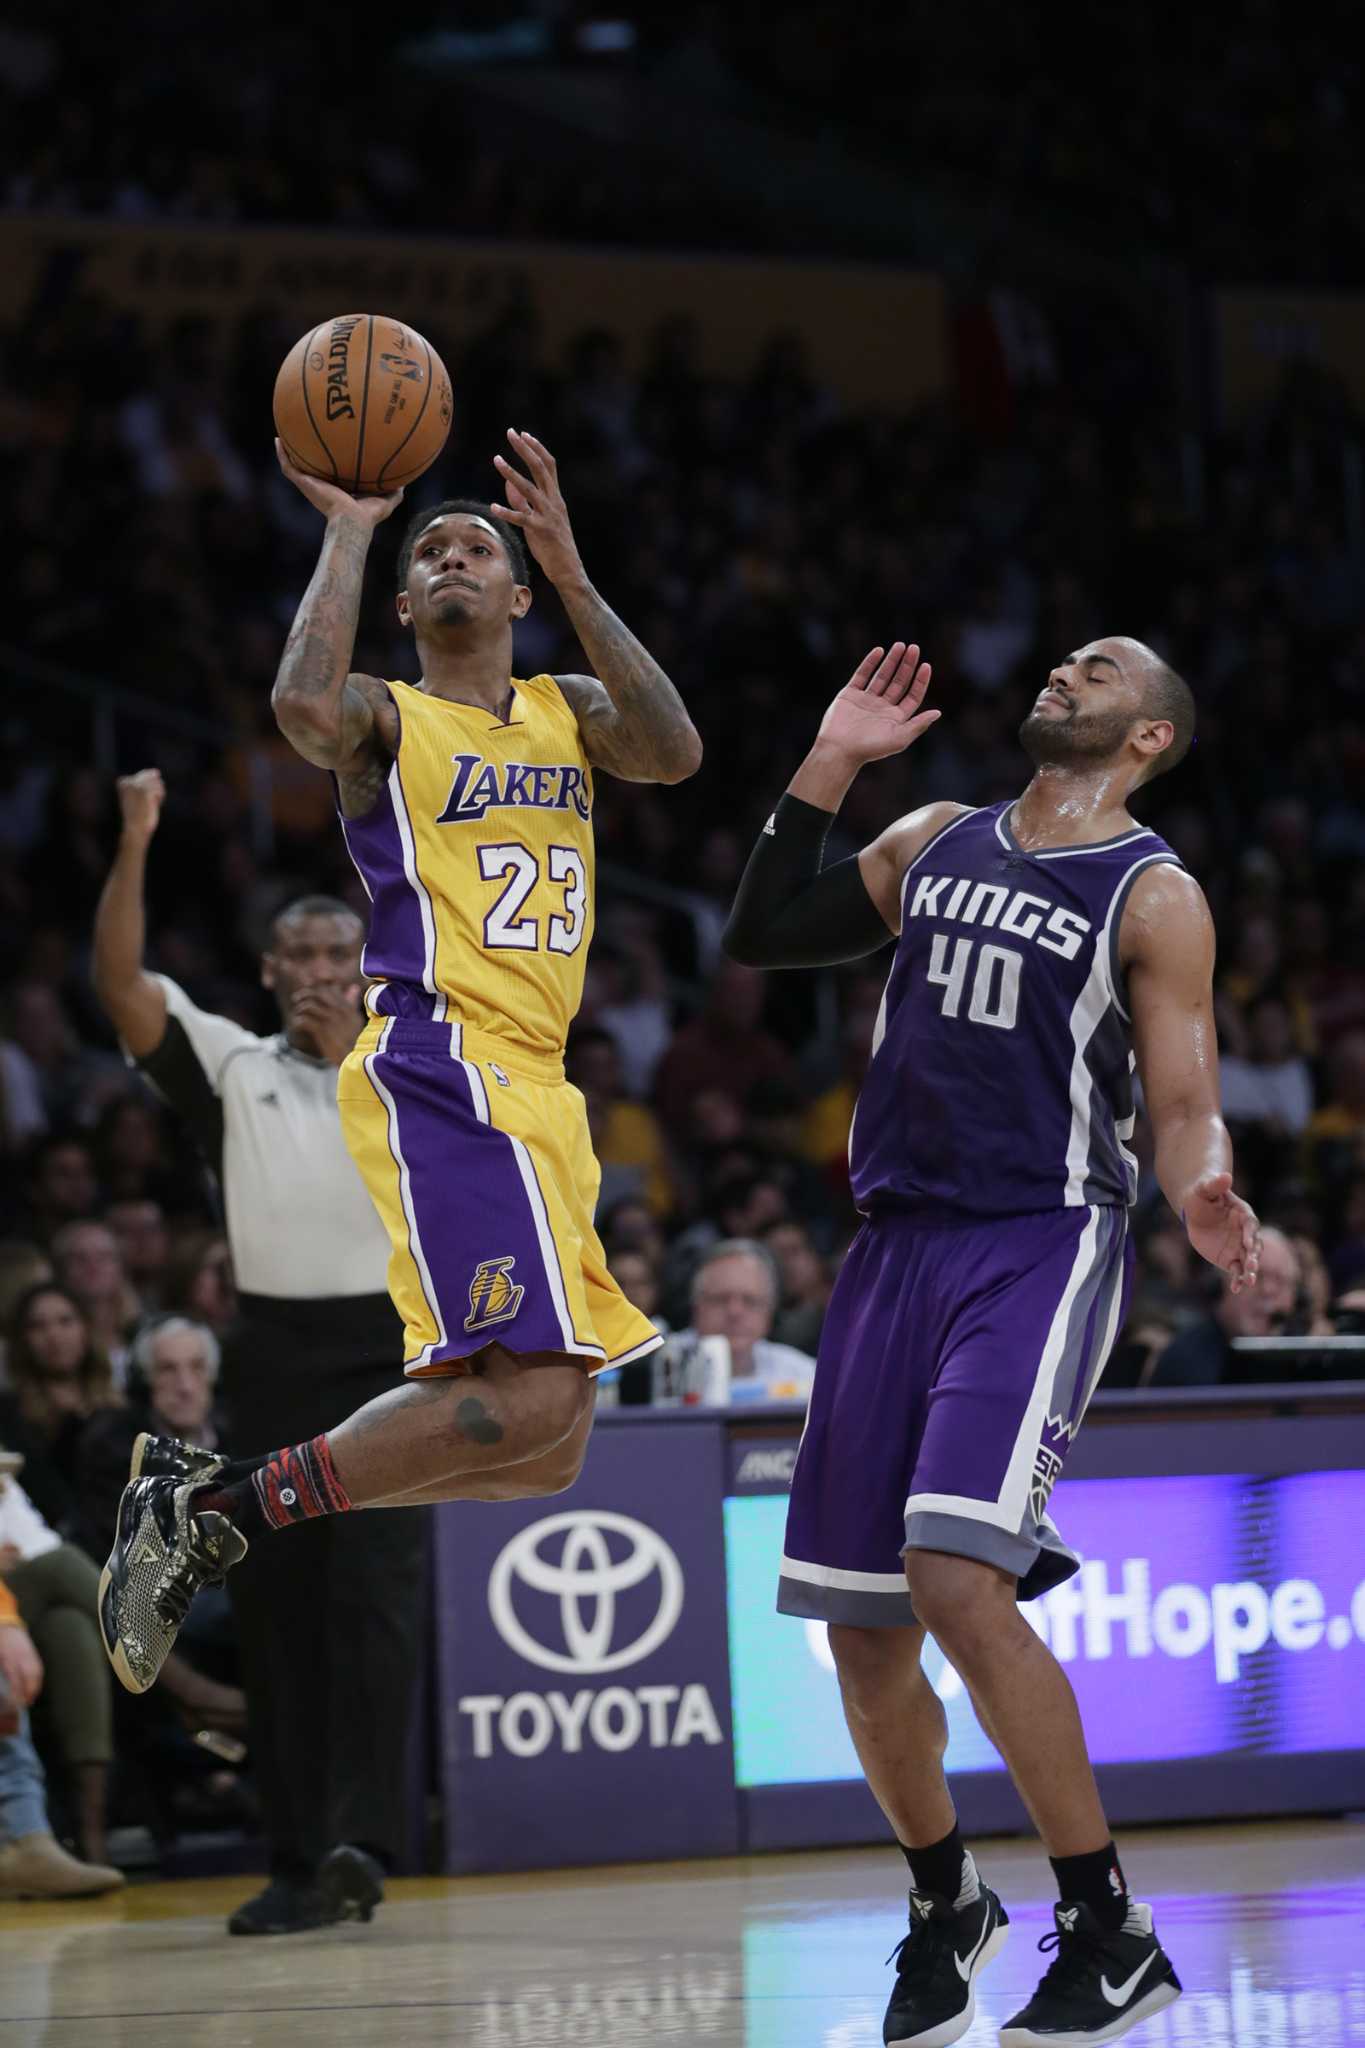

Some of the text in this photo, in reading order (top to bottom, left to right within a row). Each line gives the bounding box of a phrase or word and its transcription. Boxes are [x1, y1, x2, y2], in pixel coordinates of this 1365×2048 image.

[327, 317, 362, 421] SPALDING
[476, 842, 587, 957] 23
[909, 876, 1092, 961] KINGS
[926, 934, 1023, 1029] 40
[458, 1683, 723, 1758] TOYOTA
